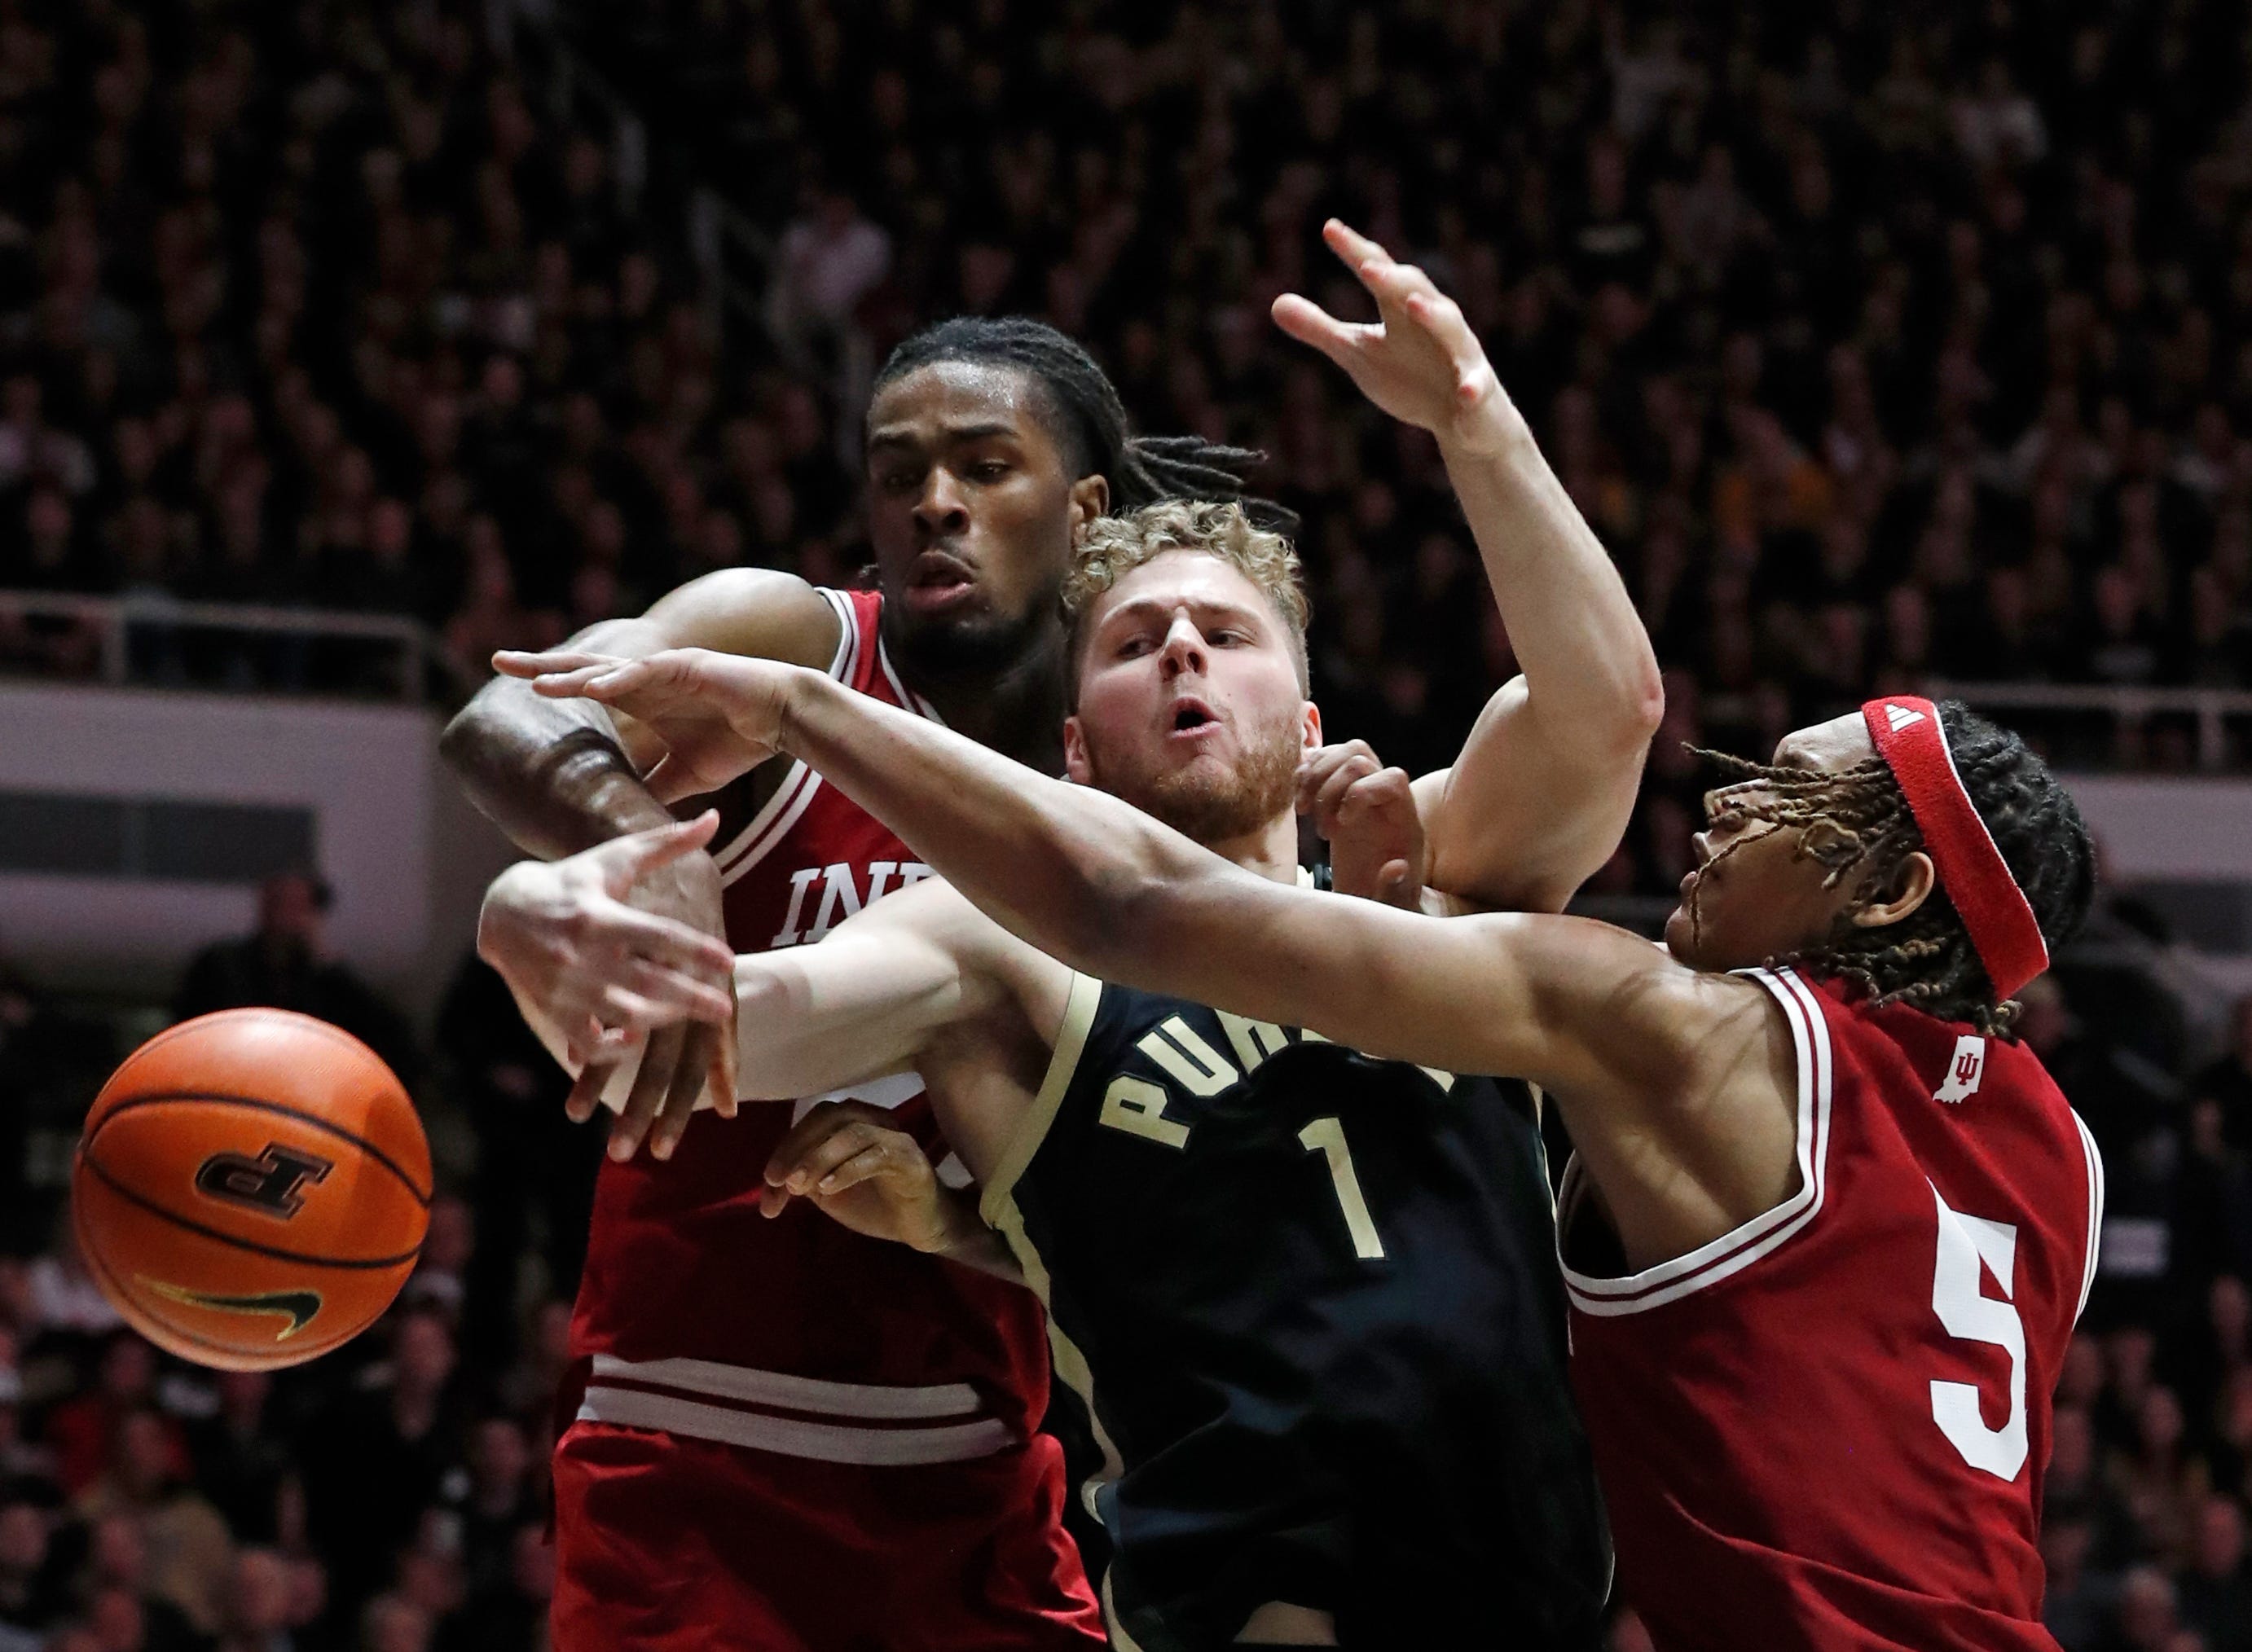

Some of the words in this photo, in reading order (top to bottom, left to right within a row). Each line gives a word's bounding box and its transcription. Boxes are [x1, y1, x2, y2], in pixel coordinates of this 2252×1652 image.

[194, 1140, 335, 1221] P
[1297, 1117, 1385, 1259] 1
[1925, 1175, 2029, 1483] 5
